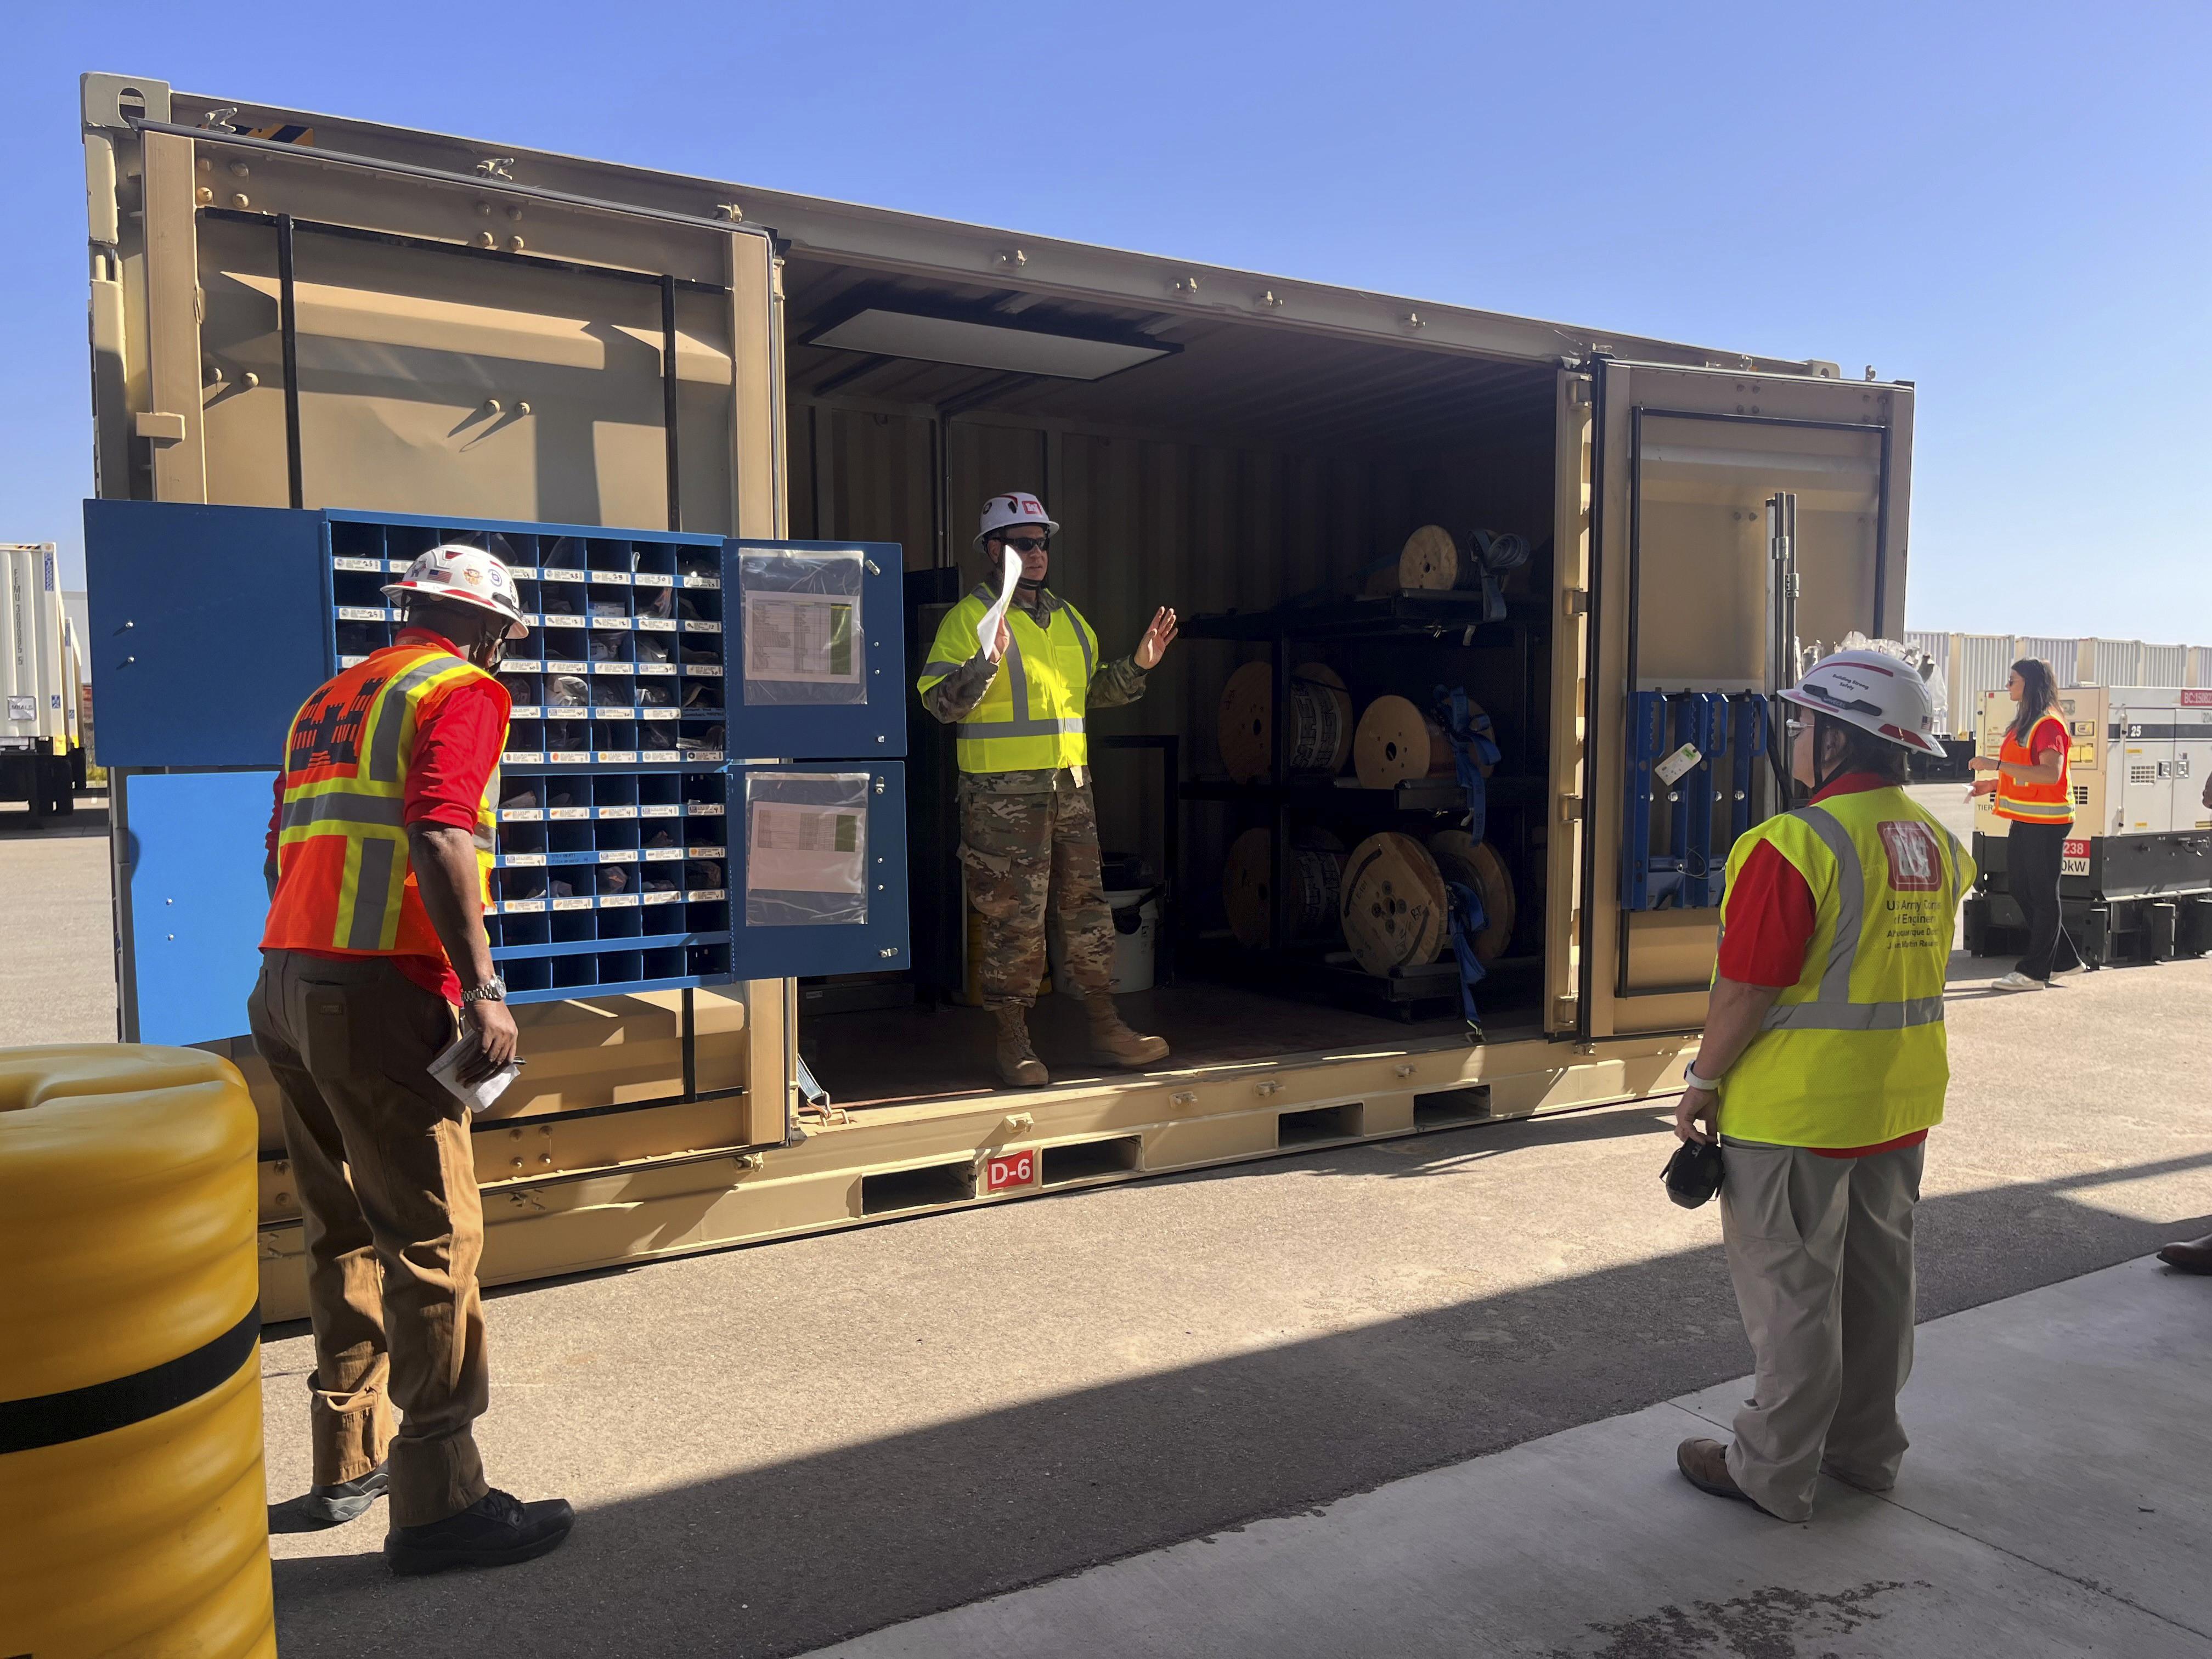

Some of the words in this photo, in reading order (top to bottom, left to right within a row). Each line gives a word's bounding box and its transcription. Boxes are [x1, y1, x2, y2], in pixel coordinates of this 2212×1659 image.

[1832, 674, 1852, 684] Building
[1852, 680, 1869, 690] Strong
[1839, 682, 1854, 691] Safety
[2130, 725, 2142, 737] 25
[1901, 900, 1921, 912] Army
[991, 1158, 1031, 1184] D-6
